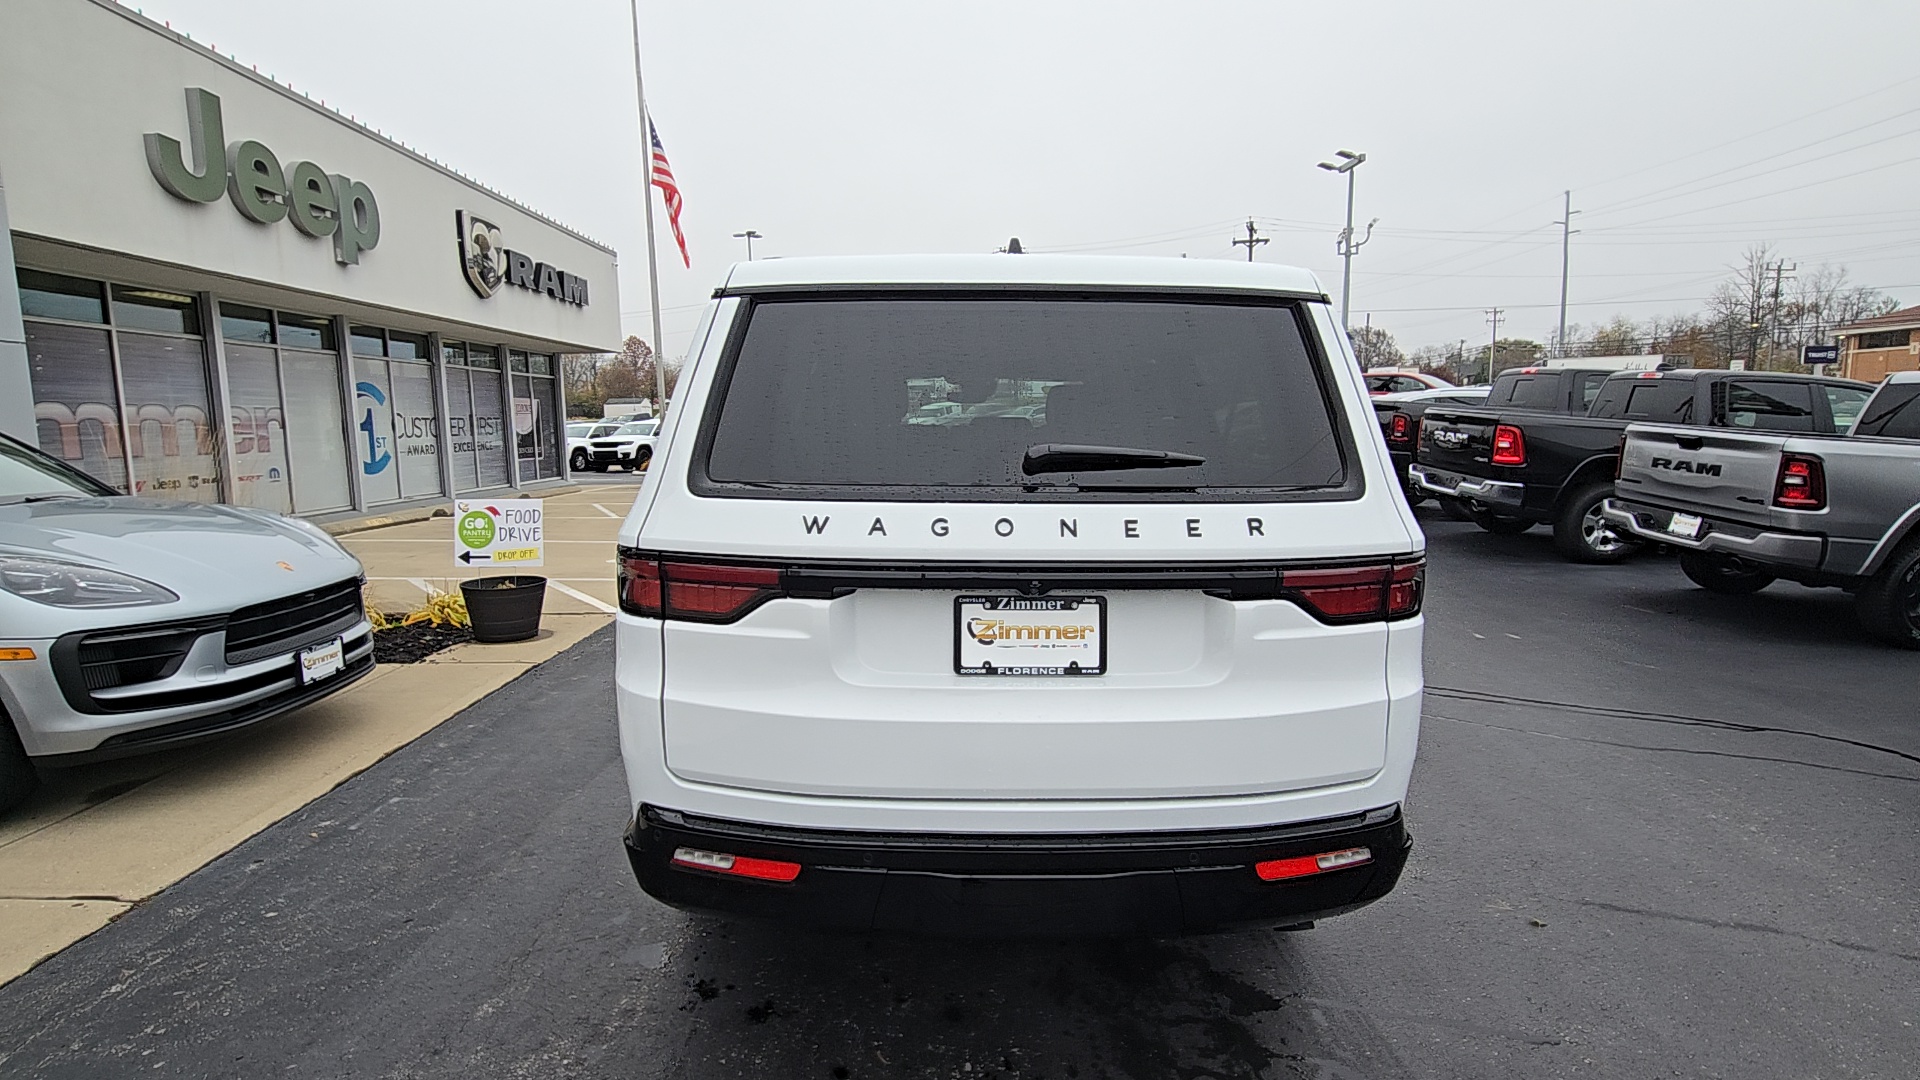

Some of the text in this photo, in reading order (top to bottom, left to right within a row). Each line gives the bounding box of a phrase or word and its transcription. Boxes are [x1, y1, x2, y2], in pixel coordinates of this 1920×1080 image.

[143, 87, 381, 266] Jeep
[503, 248, 590, 307] RAM
[392, 412, 467, 439] CUSTOER
[1433, 430, 1469, 444] RAM
[406, 441, 494, 457] AWARD EXCELENCE
[1650, 457, 1723, 478] RAM
[464, 517, 489, 529] GO!
[505, 509, 541, 524] FOOD
[498, 527, 541, 542] DRIVE
[802, 515, 1266, 539] WAGONEER
[498, 549, 535, 560] DROP OFF
[997, 597, 1065, 610] Zimmer
[973, 620, 1095, 640] Zimmer
[997, 667, 1065, 675] FLORENCE
